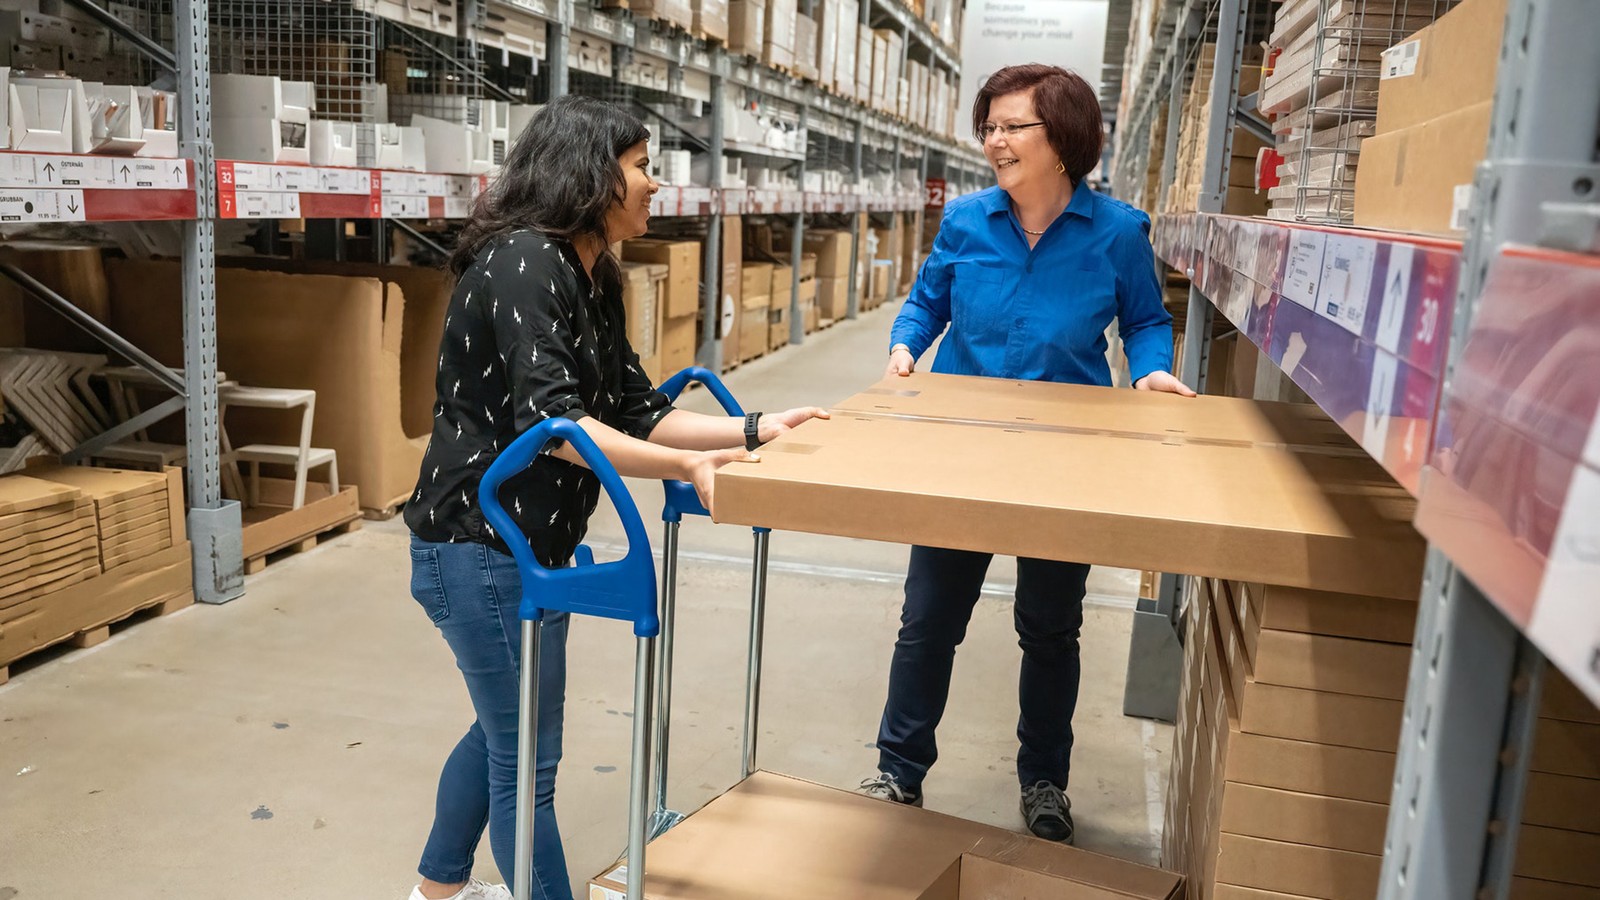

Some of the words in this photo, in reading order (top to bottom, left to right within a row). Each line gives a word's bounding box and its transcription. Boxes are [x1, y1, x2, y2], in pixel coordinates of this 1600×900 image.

[984, 2, 1025, 11] Because
[983, 16, 1038, 25] sometimes
[1041, 18, 1061, 27] you
[982, 28, 1018, 39] change
[1021, 31, 1043, 40] your
[1047, 30, 1073, 40] mind
[221, 171, 233, 184] 32
[225, 199, 231, 212] 7
